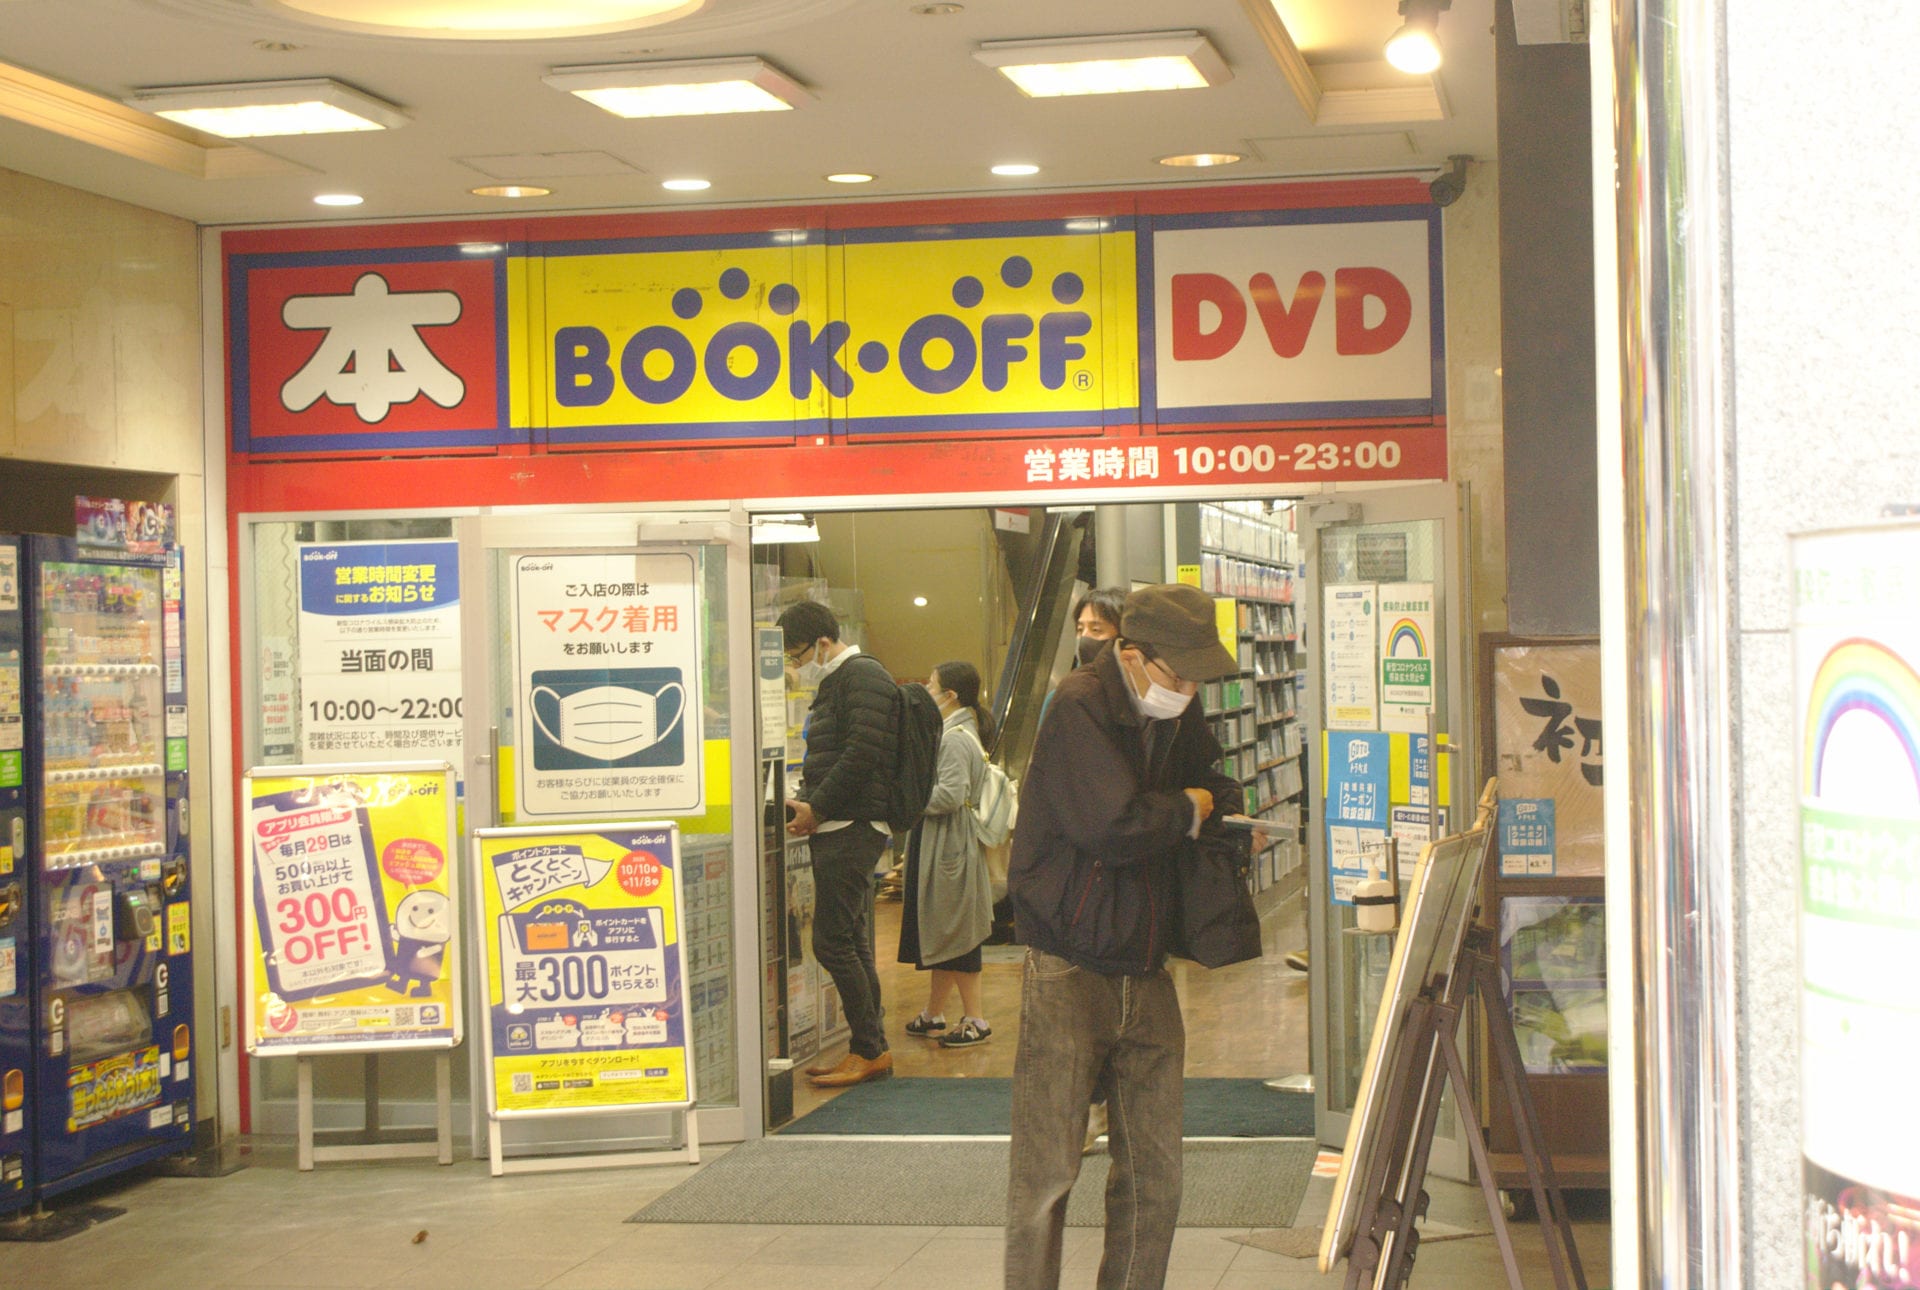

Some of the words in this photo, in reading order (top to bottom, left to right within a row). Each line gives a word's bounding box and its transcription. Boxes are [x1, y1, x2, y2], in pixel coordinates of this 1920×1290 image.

[1172, 266, 1412, 361] DVD
[281, 272, 465, 424] 本
[1024, 446, 1159, 483] 営業時間
[1174, 440, 1401, 474] 10:00-23:00
[335, 564, 436, 585] 営業時間変更
[335, 585, 436, 604] に関するお知らせ
[565, 582, 650, 598] ご入店の際は
[537, 605, 679, 634] マスク着用
[563, 641, 654, 656] をお願いします
[341, 648, 433, 673] 当面の間
[1343, 793, 1373, 806] クーポン
[280, 834, 353, 858] 毎月29日は
[512, 846, 567, 861] ポイントカード
[275, 859, 352, 881] 500円以上
[511, 857, 572, 883] とくとく
[506, 870, 582, 901] キャンペーン
[277, 887, 368, 934] 300円
[595, 917, 647, 927] ポイントカードを
[608, 926, 635, 935] アプリに
[284, 922, 372, 965] OFF!
[539, 954, 609, 1002] 300
[610, 964, 656, 977] ポイント
[611, 977, 660, 991] もらえる!
